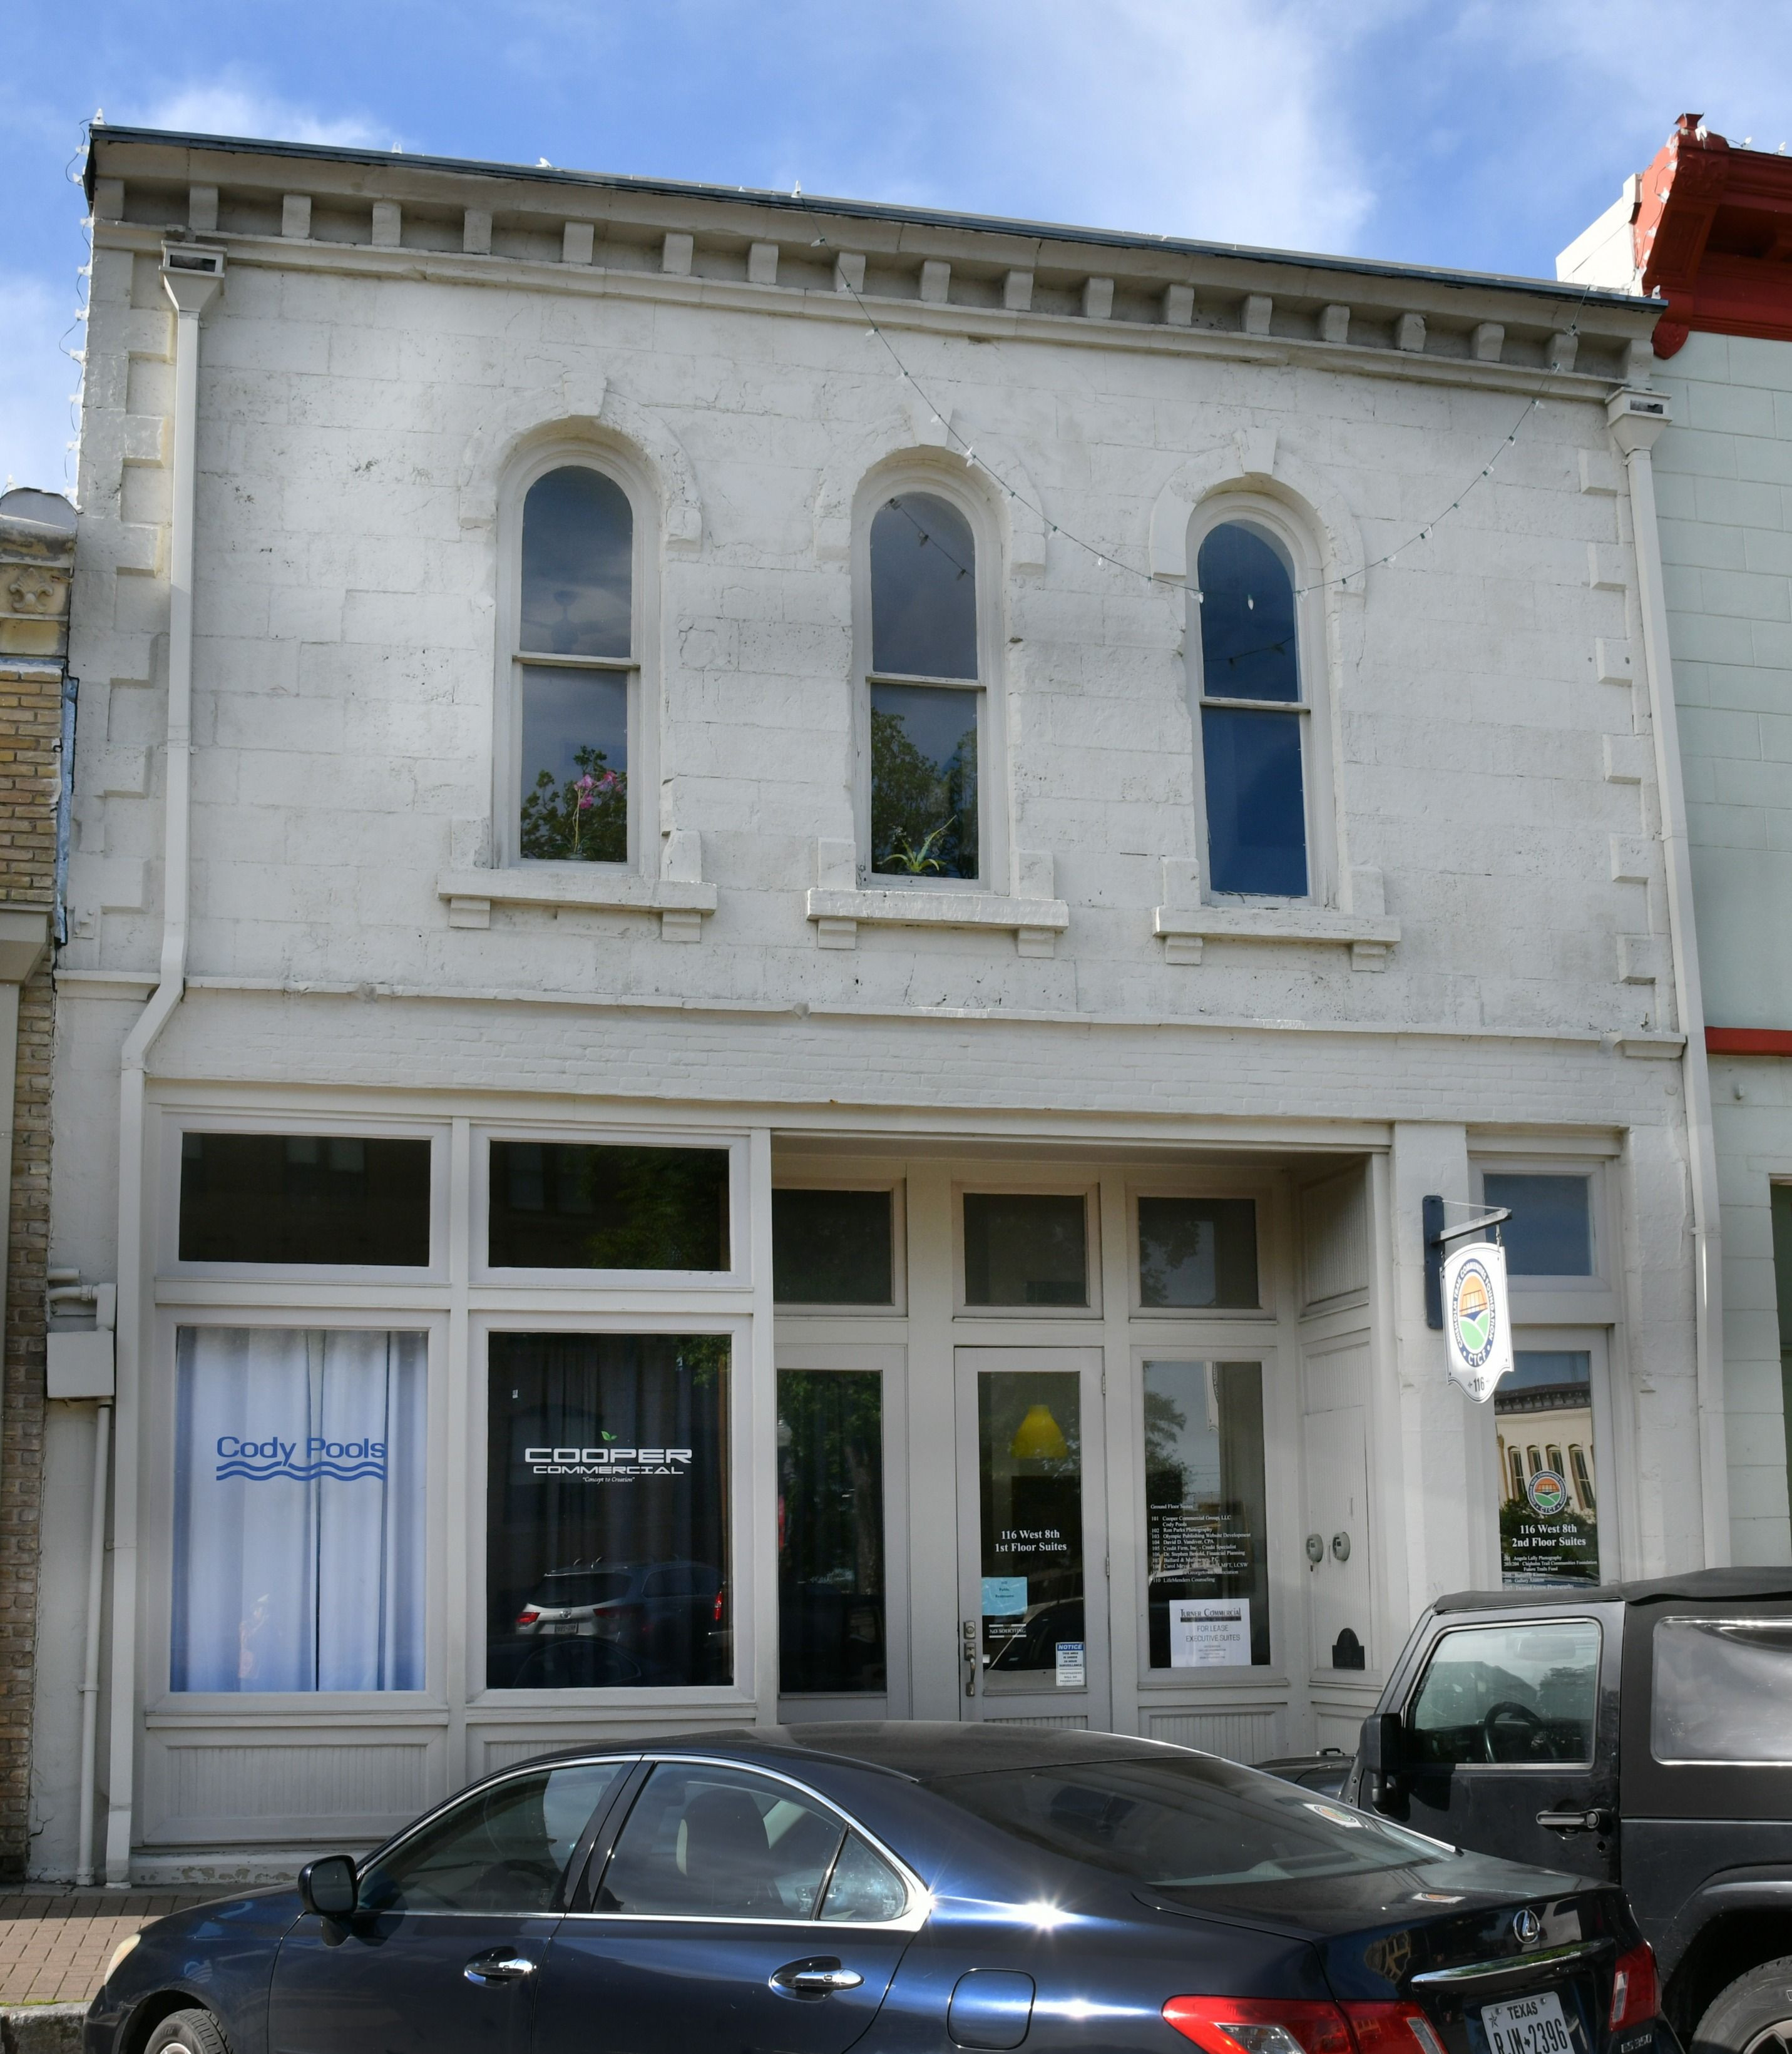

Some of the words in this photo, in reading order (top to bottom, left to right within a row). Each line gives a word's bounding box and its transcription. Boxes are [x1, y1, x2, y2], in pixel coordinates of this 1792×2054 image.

[1485, 1278, 1495, 1341] FOUNDATION
[1468, 1349, 1487, 1366] CTCF
[1473, 1377, 1485, 1392] 116
[217, 1436, 297, 1466] Cody
[307, 1438, 386, 1458] Pools
[525, 1448, 692, 1463] COOPER
[533, 1466, 684, 1474] COMMERCIAL
[1001, 1531, 1016, 1540] 116
[1020, 1530, 1042, 1539] West
[1045, 1530, 1060, 1538] 8th
[1520, 1525, 1535, 1534] 116
[1538, 1525, 1560, 1533] West
[1562, 1524, 1577, 1533] 8th
[995, 1543, 1008, 1552] 1st
[1011, 1543, 1036, 1552] Floor
[1039, 1542, 1067, 1551] Suites
[1512, 1538, 1529, 1547] 2nd
[1532, 1537, 1557, 1546] Floor
[1559, 1536, 1586, 1546] Suites
[1507, 2001, 1538, 2020] TEXAS
